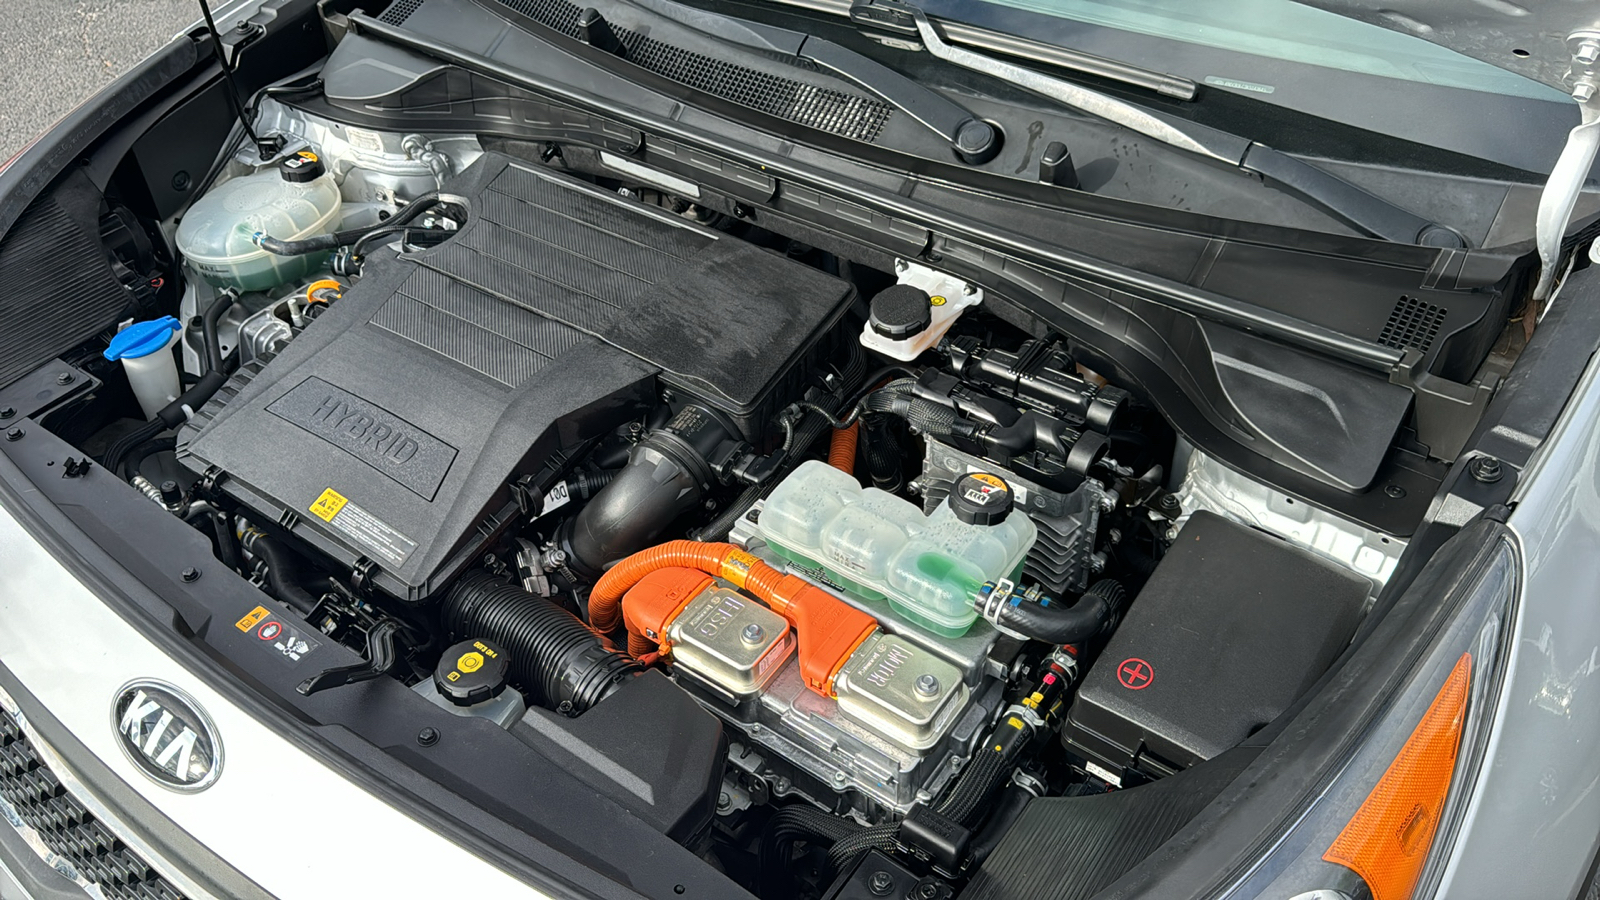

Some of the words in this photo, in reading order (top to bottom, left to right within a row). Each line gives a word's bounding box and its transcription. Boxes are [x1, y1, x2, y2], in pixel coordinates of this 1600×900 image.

[311, 396, 419, 464] HYBRID
[700, 600, 740, 636] HSG
[866, 648, 908, 687] MOTOR
[119, 689, 198, 782] KIA
